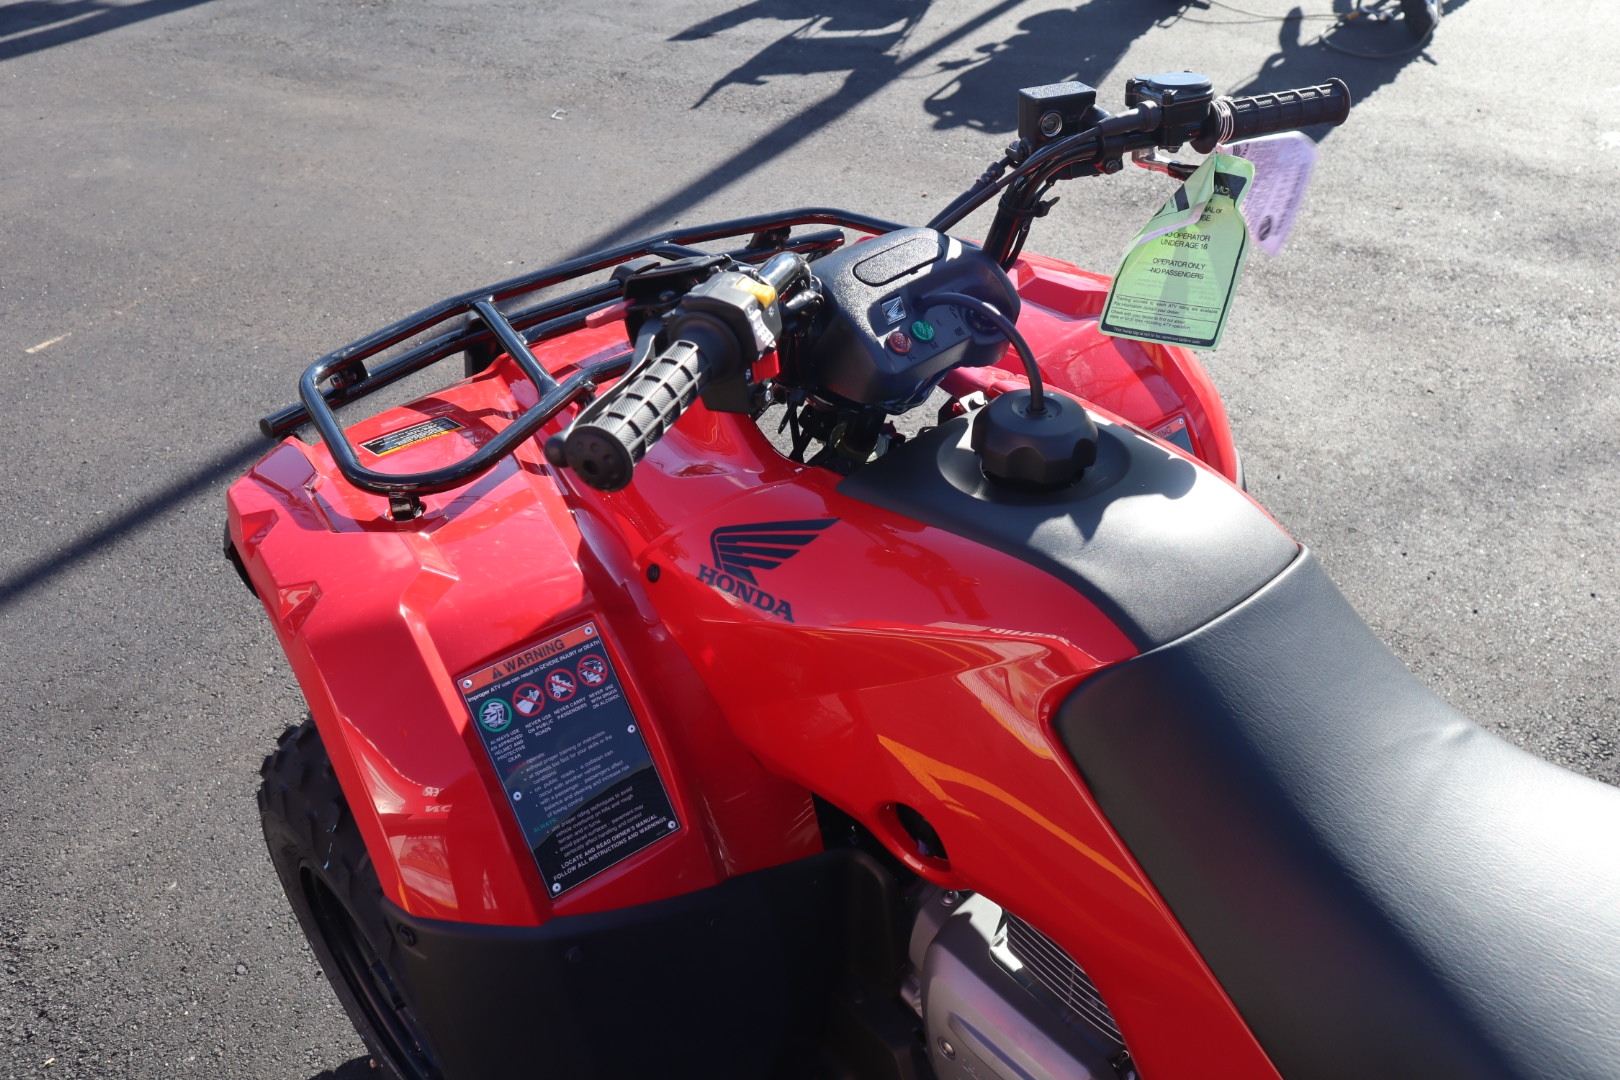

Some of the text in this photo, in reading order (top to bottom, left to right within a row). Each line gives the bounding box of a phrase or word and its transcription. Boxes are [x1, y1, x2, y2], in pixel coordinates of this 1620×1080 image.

[1161, 239, 1184, 247] UNDER
[1174, 232, 1211, 242] OPERATOR
[1153, 258, 1187, 268] OPERATOR
[1161, 269, 1204, 280] PASSENGERS
[696, 564, 795, 622] HONDA
[503, 638, 565, 673] WARNING
[467, 689, 490, 703] Improper
[489, 684, 501, 692] ATV
[519, 669, 534, 678] result
[538, 657, 559, 670] SEVERE
[559, 649, 577, 661] INJURY
[582, 639, 599, 650] DEATH
[587, 683, 614, 699] NEVER USE
[599, 693, 620, 705] ALCOHOL
[553, 696, 586, 715] NEVER CARRY
[556, 702, 587, 720] PASSENGERS
[524, 712, 552, 729] NEVER USE
[534, 718, 554, 730] PUBLIC
[489, 732, 510, 745] ALWAYS
[534, 725, 551, 737] ROADS
[493, 739, 523, 756] HELMET AND
[498, 733, 523, 747] APPROVED
[496, 744, 526, 761] PROTECTIVE
[506, 753, 521, 763] GEAR
[525, 760, 543, 772] without
[543, 753, 559, 764] proper
[558, 744, 577, 757] training
[581, 730, 605, 744] instruction
[542, 777, 559, 788] public
[559, 768, 575, 779] roads
[583, 754, 604, 767] collision
[538, 763, 601, 798] occur with another vehicle
[560, 813, 658, 868] LOCATE AND READ OWNER'S MANUAL
[552, 864, 576, 880] FOLLOW
[576, 858, 588, 868] ALL
[587, 837, 627, 862] INSTRUCTIONS
[626, 831, 639, 841] AND
